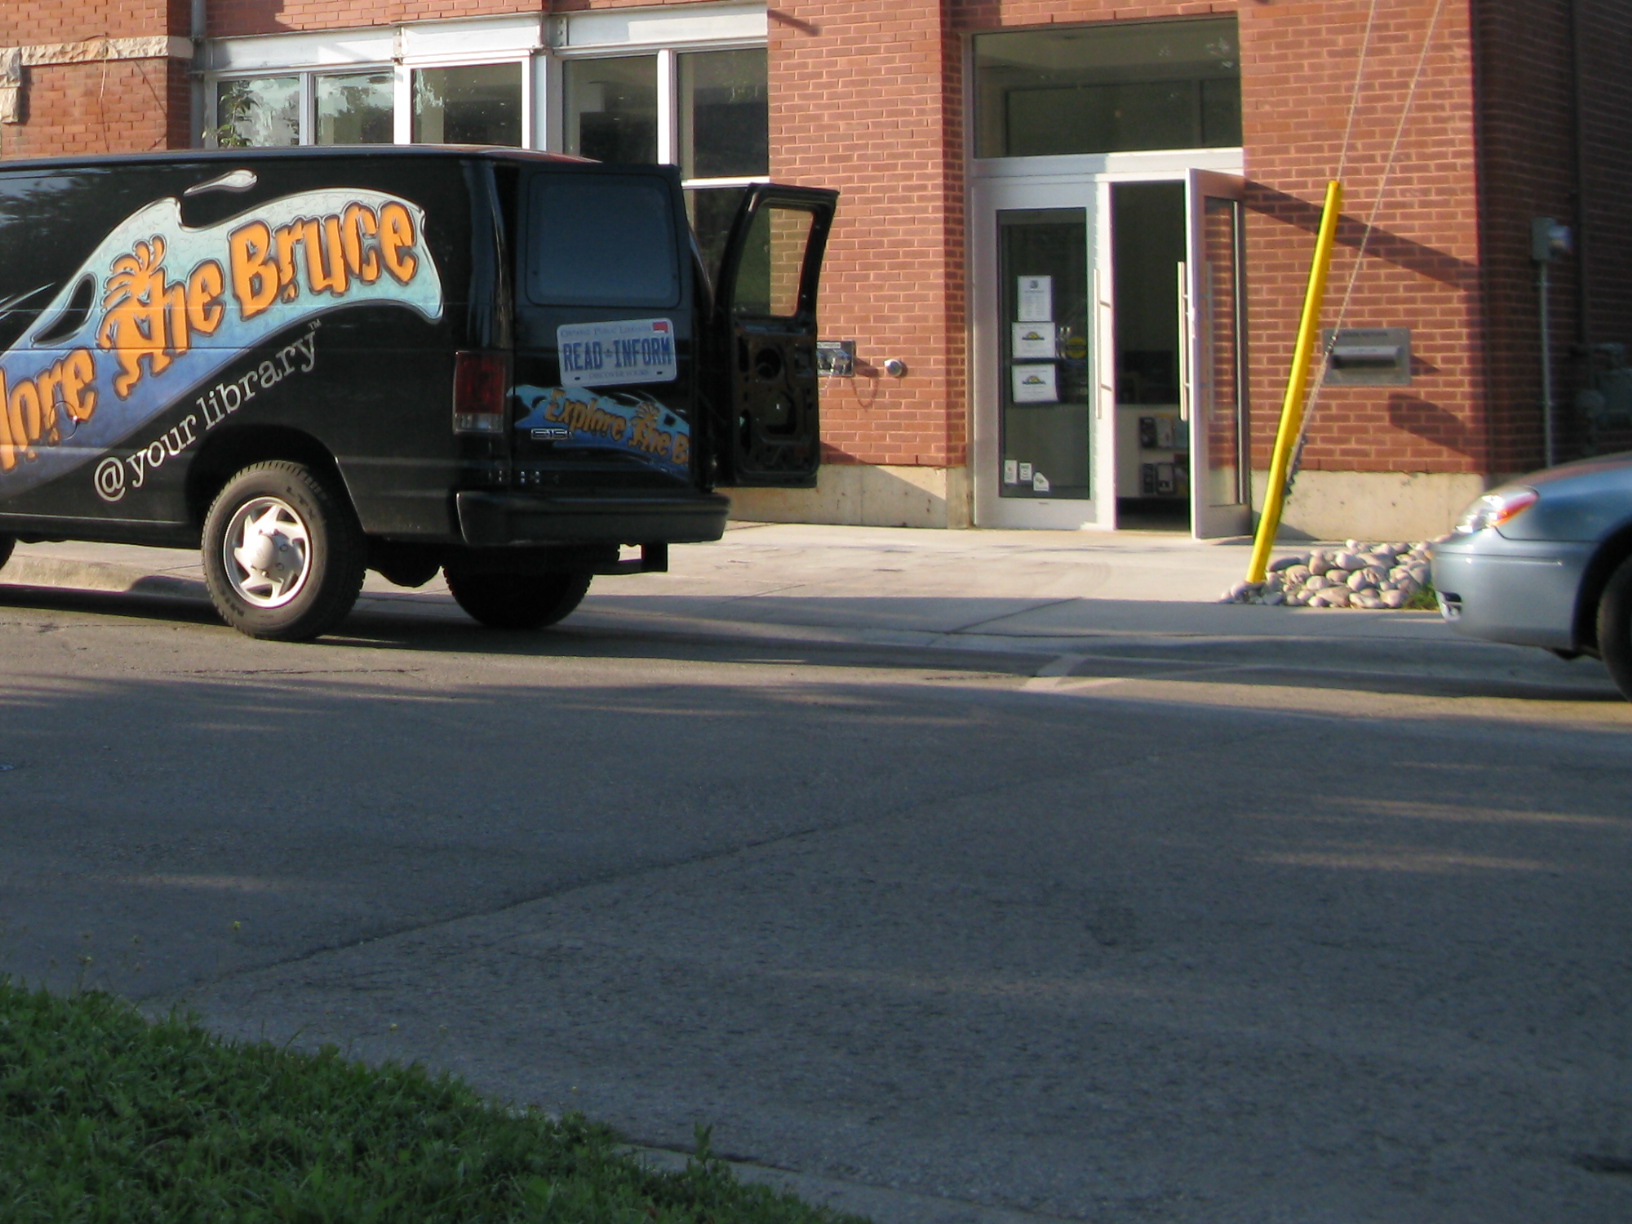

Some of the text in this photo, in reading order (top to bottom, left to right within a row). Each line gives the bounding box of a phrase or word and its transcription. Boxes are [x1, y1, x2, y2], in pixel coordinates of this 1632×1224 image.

[228, 201, 418, 321] Bruce
[562, 337, 672, 372] READ INFORM
[543, 389, 627, 441] Explore
